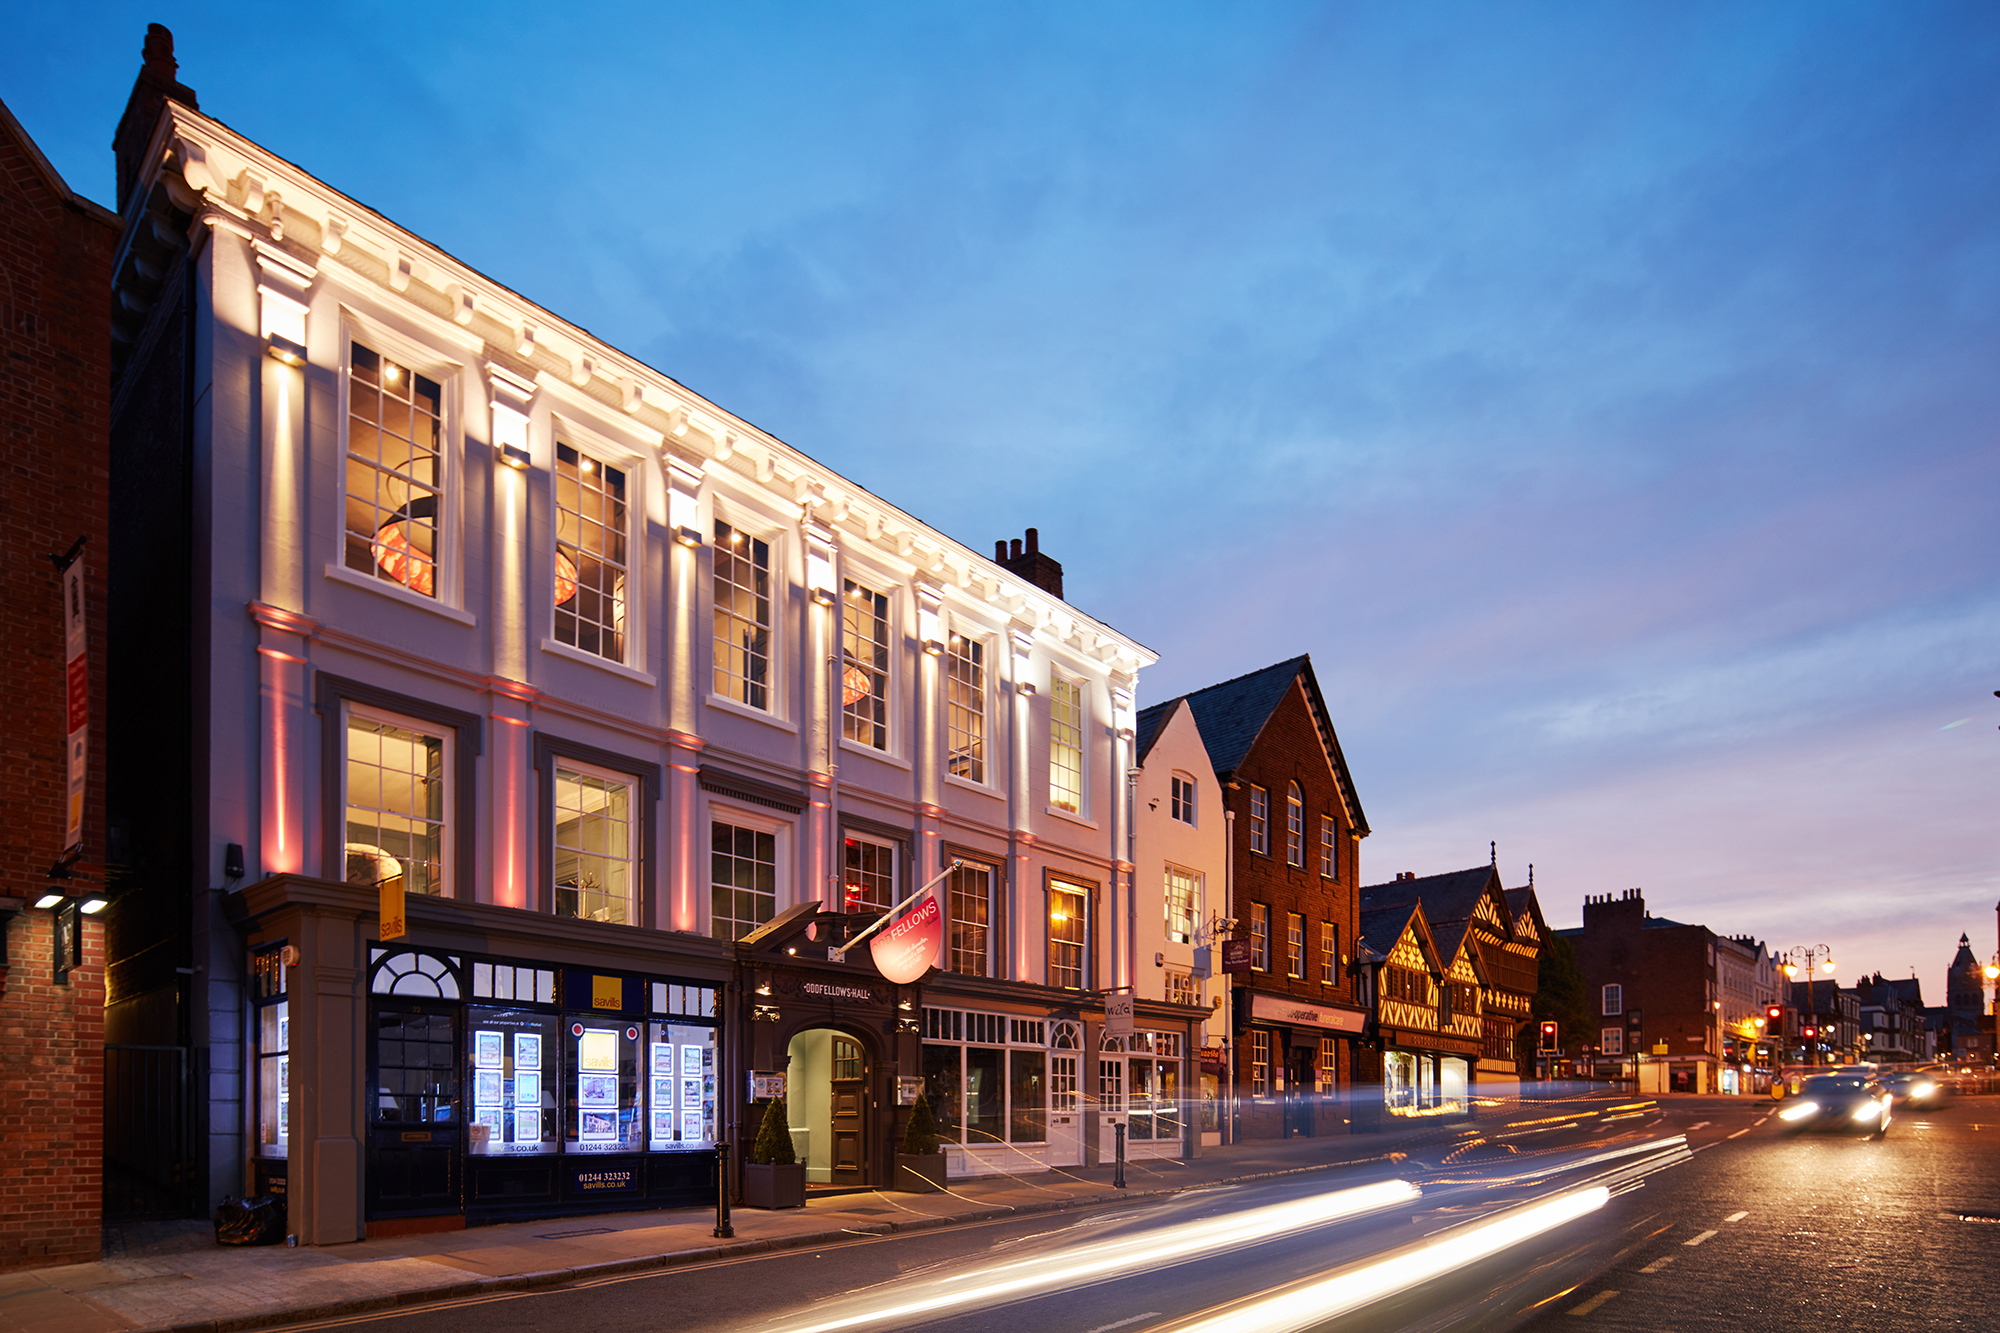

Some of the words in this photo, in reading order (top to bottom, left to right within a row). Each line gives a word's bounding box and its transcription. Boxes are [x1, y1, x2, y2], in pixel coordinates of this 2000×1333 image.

[381, 916, 402, 938] savills
[872, 902, 937, 954] ODDFELLOWS
[593, 997, 621, 1008] savills
[585, 1056, 614, 1068] savills
[580, 1143, 602, 1151] 01244
[578, 1173, 602, 1182] 01244
[603, 1171, 631, 1181] 323232
[583, 1180, 626, 1190] savills.co.uk
